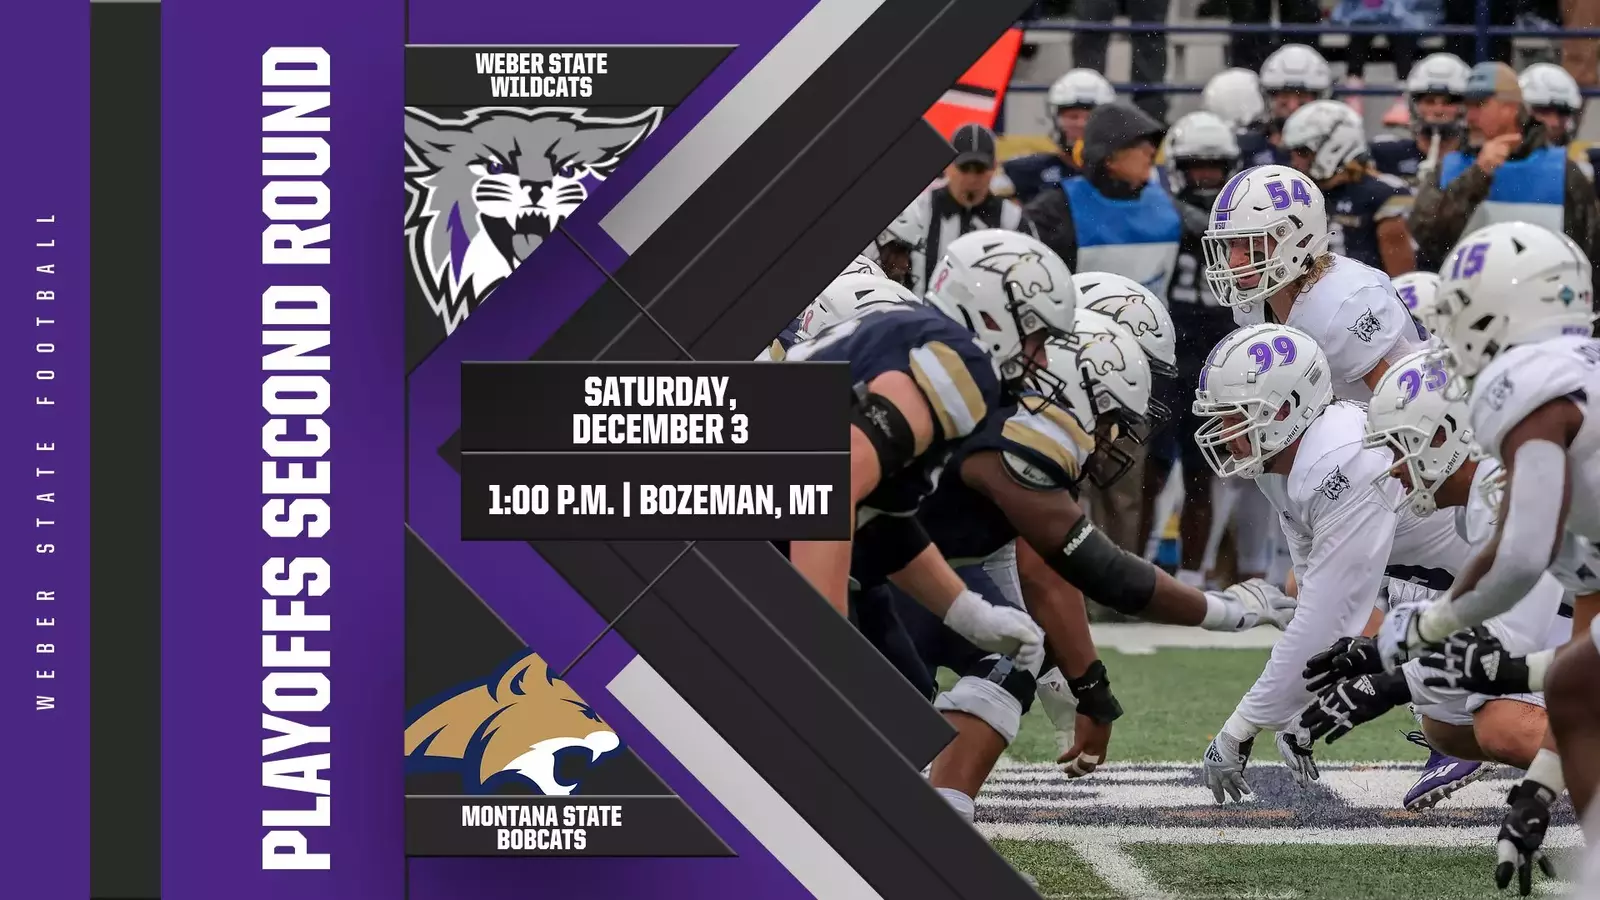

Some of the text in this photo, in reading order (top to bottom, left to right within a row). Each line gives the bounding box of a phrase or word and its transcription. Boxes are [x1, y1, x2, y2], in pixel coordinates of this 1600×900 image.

[1264, 179, 1312, 210] 54
[1451, 242, 1491, 280] 15
[1247, 335, 1297, 376] 99
[1397, 359, 1448, 404] 93
[1284, 424, 1300, 446] schutt
[1444, 450, 1460, 475] schutt
